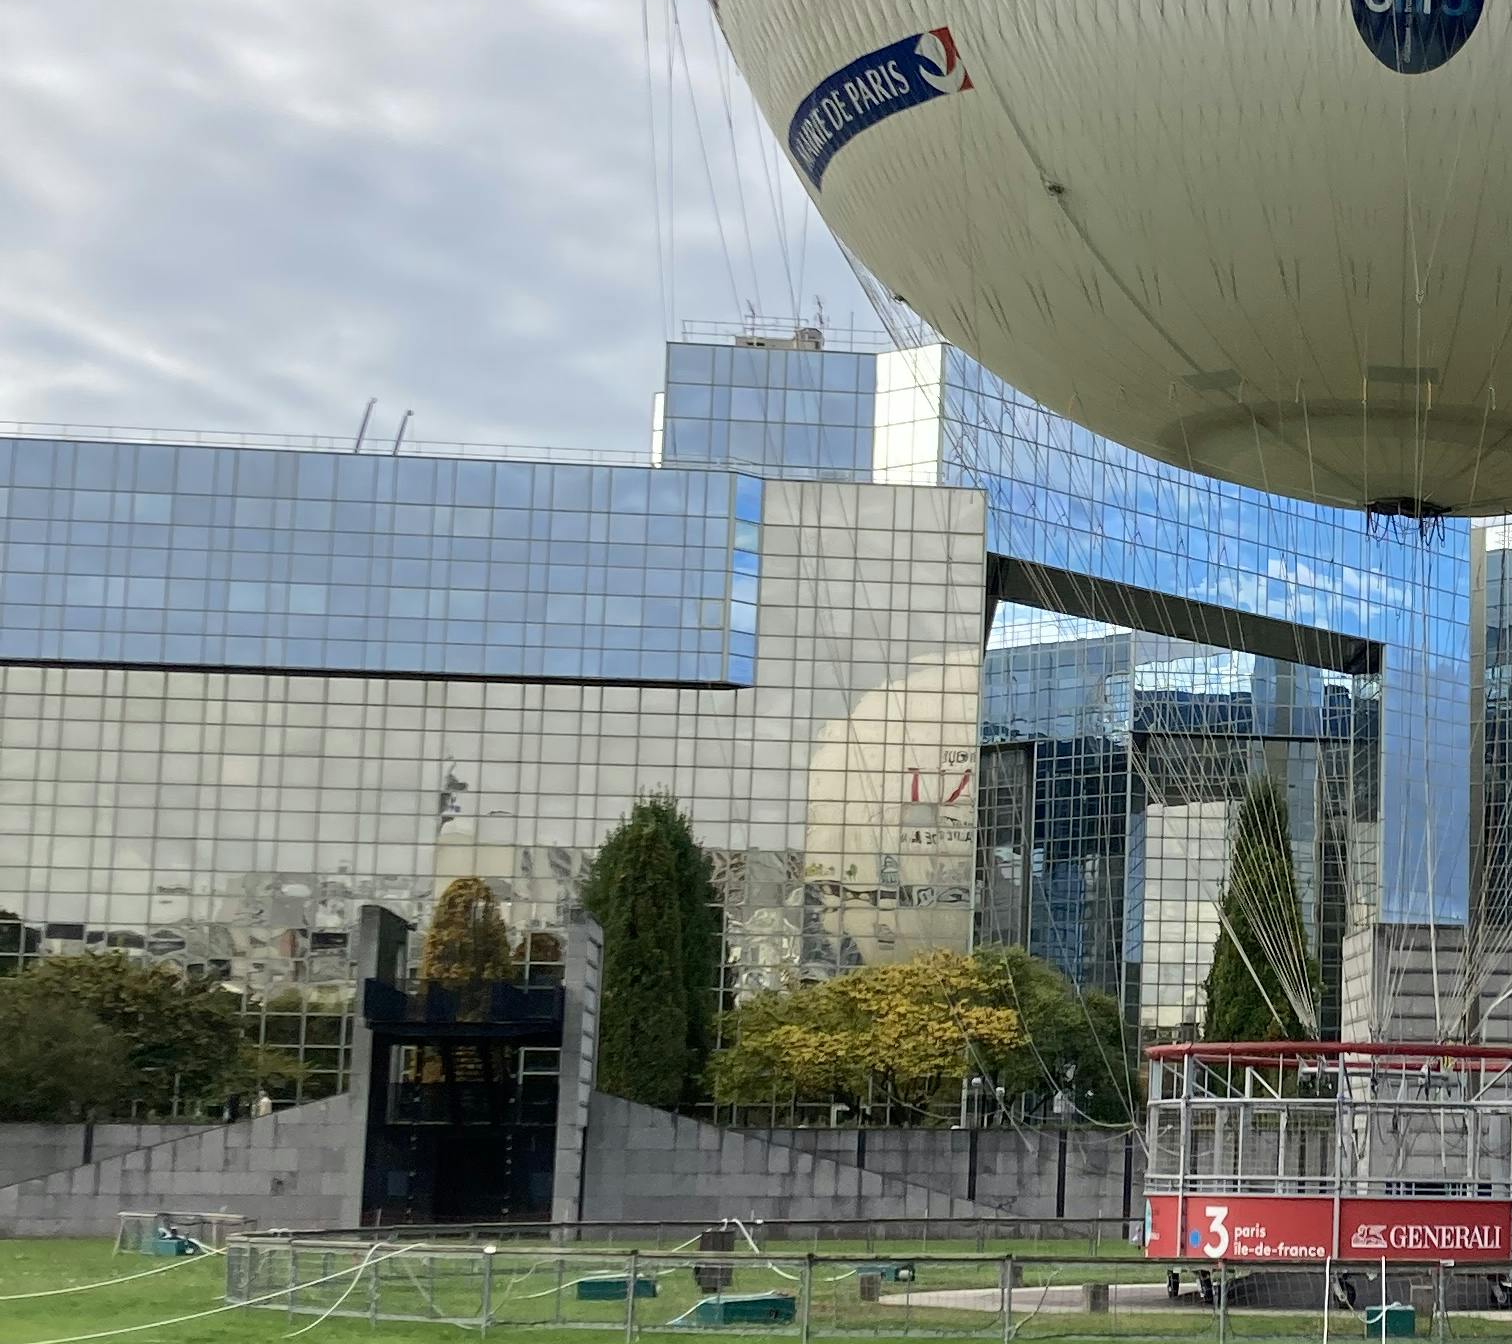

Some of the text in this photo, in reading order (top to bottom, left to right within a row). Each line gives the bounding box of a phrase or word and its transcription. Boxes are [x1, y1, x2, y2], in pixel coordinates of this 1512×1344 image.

[821, 89, 853, 131] DE
[844, 60, 910, 114] PARIS
[1203, 1206, 1229, 1258] 3
[1233, 1223, 1266, 1240] paris
[1389, 1224, 1502, 1249] GENERALI
